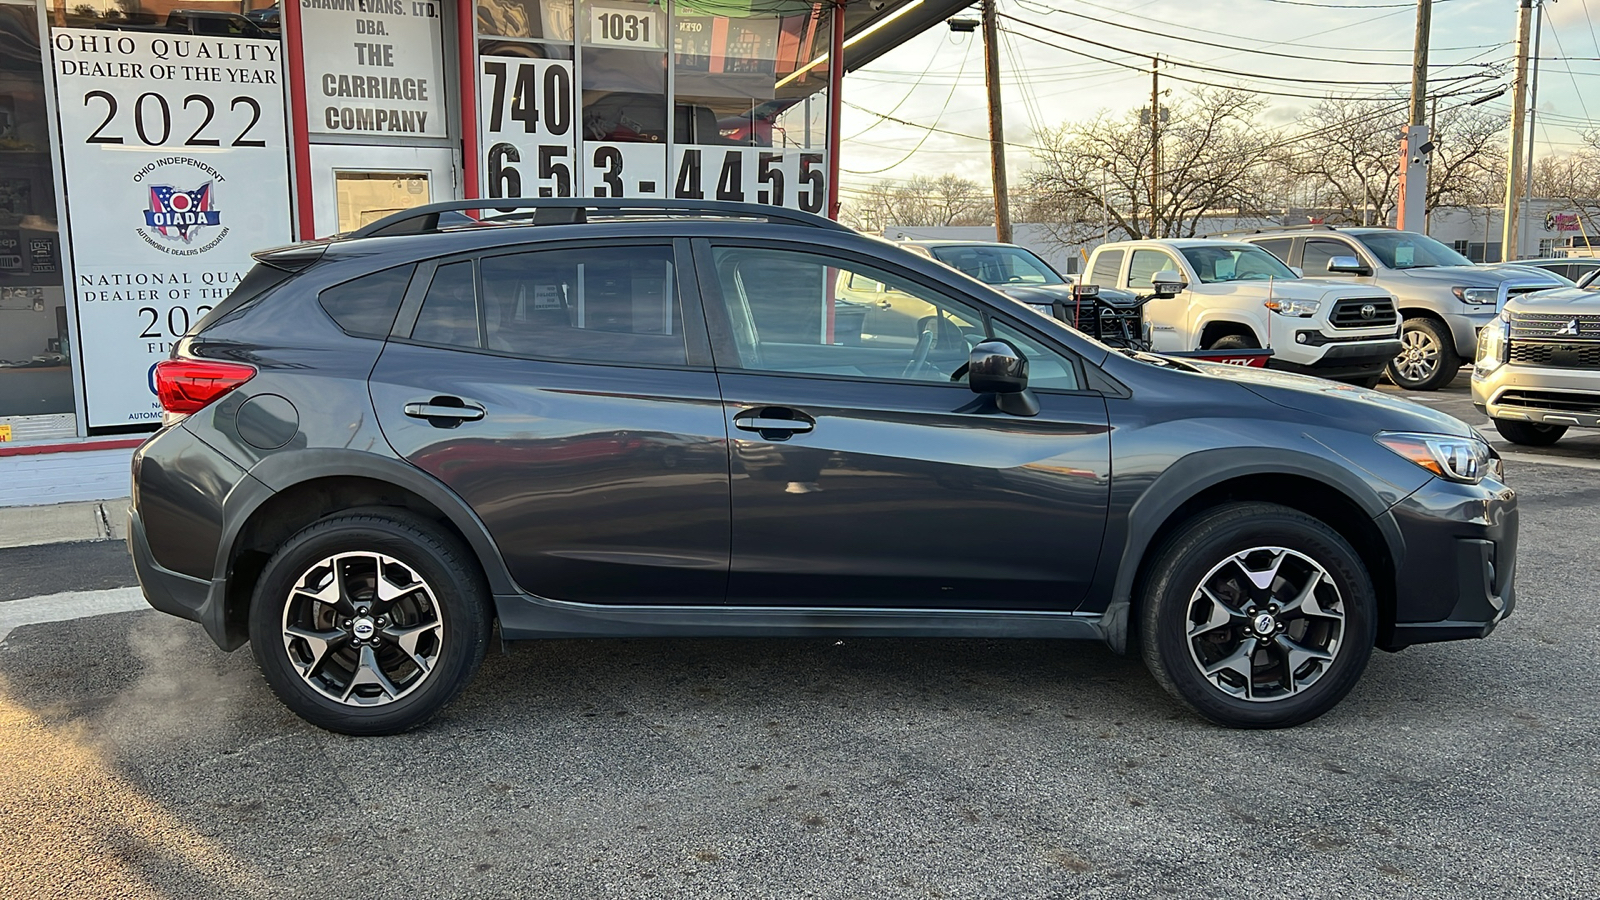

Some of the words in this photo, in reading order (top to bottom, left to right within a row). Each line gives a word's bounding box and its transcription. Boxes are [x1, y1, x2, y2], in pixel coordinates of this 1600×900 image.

[412, 1, 439, 18] LTD.
[356, 19, 389, 36] DBA.
[598, 13, 650, 42] 1031
[55, 33, 136, 54] OHIO
[151, 39, 278, 62] QUALITY
[354, 42, 394, 67] THE
[61, 60, 144, 79] DEALER
[150, 64, 176, 80] OF
[181, 66, 221, 82] THE
[227, 68, 278, 84] YEAR
[322, 73, 428, 101] CARRIAGE
[484, 61, 570, 136] 740
[83, 90, 266, 147] 2022
[325, 106, 428, 133] COMPANY
[133, 163, 156, 182] OHIO
[156, 157, 226, 183] INDEPENDENT
[154, 212, 208, 225] OIADA
[136, 228, 170, 254] AUTOMOBILE
[171, 248, 199, 256] DEALERS
[199, 226, 230, 254] ASSOCIATION
[80, 273, 192, 287] NATIONAL
[202, 272, 249, 285] QUA
[84, 289, 160, 302] DEALER
[169, 288, 191, 300] OF
